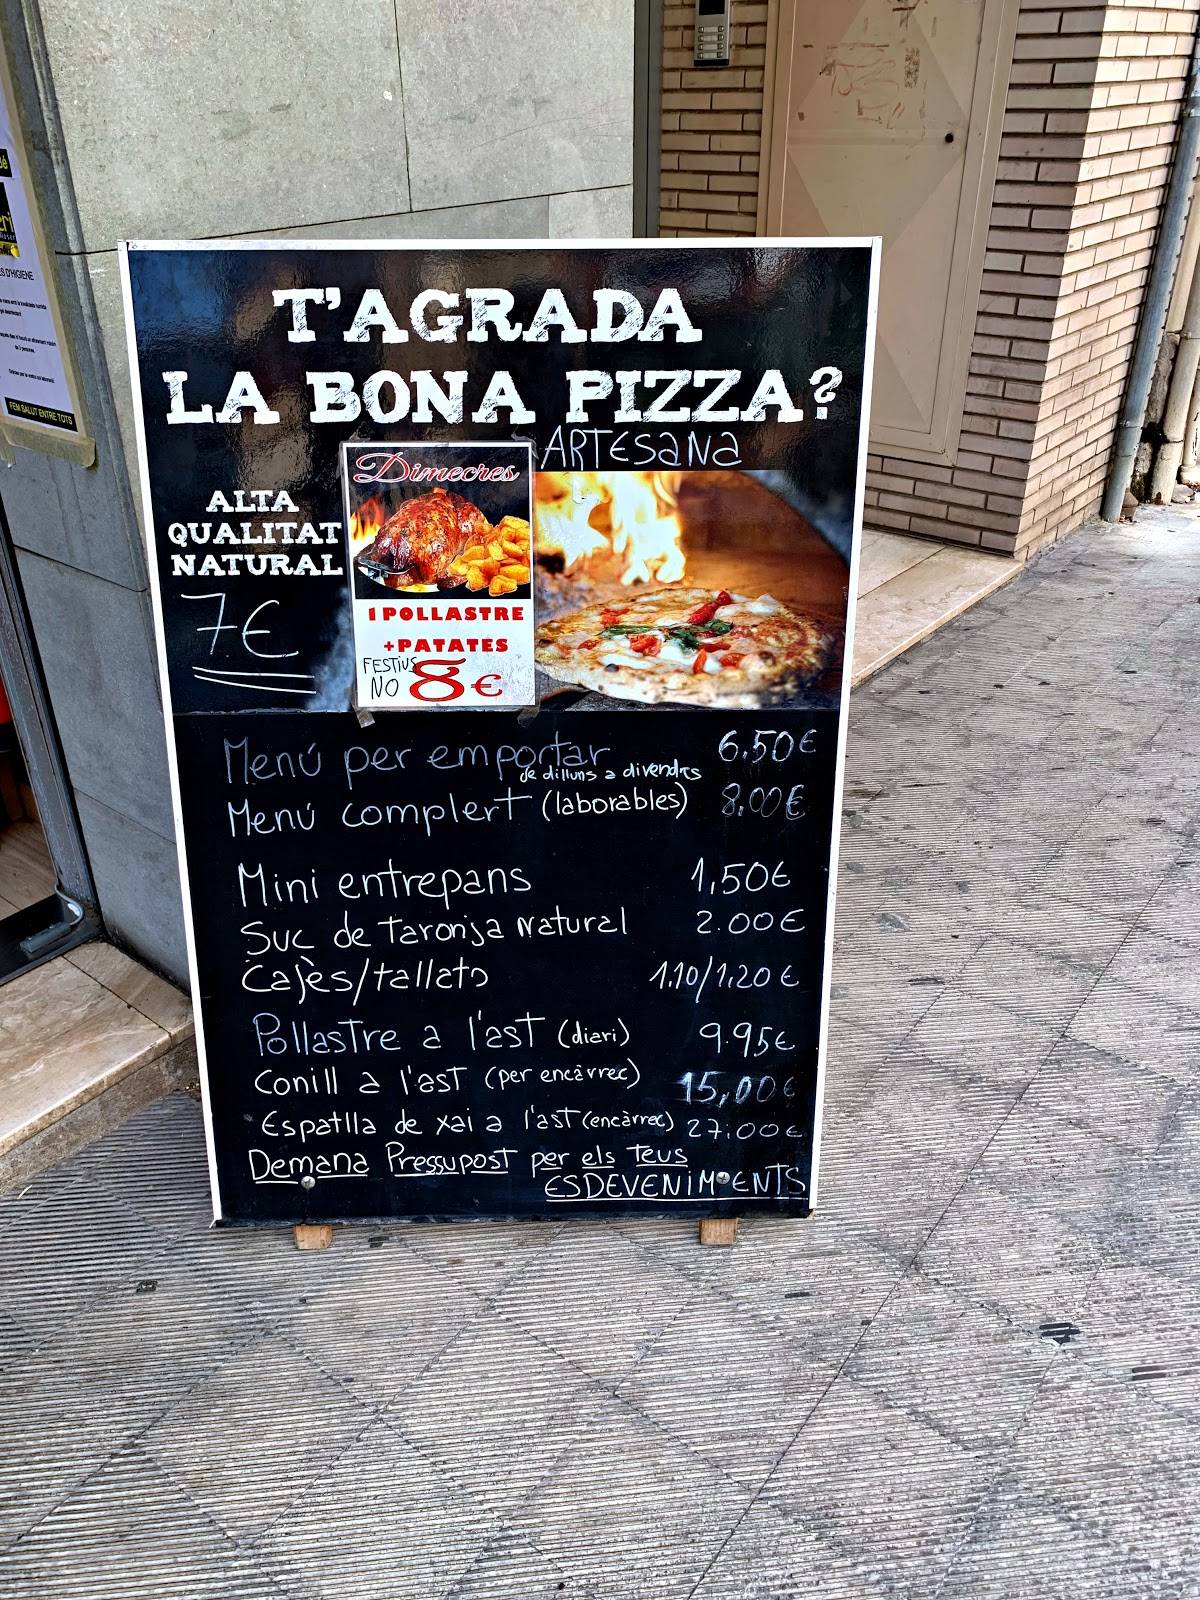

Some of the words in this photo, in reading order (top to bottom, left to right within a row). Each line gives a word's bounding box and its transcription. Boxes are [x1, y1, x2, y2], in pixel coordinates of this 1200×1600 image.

[272, 286, 703, 344] T'AGRADA
[162, 371, 280, 425] LA
[306, 369, 536, 425] BONA
[566, 366, 843, 424] PIZZA?
[8, 401, 22, 412] FEM
[21, 404, 38, 416] SALUT
[38, 408, 58, 420] ENTRE
[57, 412, 73, 425] TOTS
[353, 451, 520, 483] Dimecres
[206, 490, 299, 513] ALTA
[167, 522, 341, 545] QUALITAT
[171, 553, 343, 577] NATURAL
[383, 606, 524, 621] POLLASTRE
[371, 675, 399, 700] NO
[224, 737, 321, 784] Menú
[344, 745, 412, 790] per
[427, 731, 611, 780] emportar
[520, 766, 537, 783] de
[543, 765, 598, 782] dilluns
[605, 770, 616, 780] a
[228, 799, 315, 837] Menú
[342, 787, 533, 837] complert
[542, 782, 688, 822] (laborables)
[238, 863, 319, 908] Mini
[339, 858, 532, 910] entrepans
[240, 921, 315, 955] Suc
[333, 910, 372, 948] de
[252, 1012, 401, 1057] Pollastre
[422, 1025, 443, 1049] a
[557, 1017, 631, 1049] (diari)
[254, 1065, 338, 1096] Conill
[358, 1071, 381, 1094] a
[484, 1066, 533, 1091] (per
[261, 1110, 377, 1143] Espatlla
[394, 1108, 423, 1136] de
[435, 1107, 473, 1136] xai
[485, 1115, 503, 1133] a
[248, 1148, 371, 1182] Demana
[385, 1141, 518, 1176] Pressupost
[531, 1151, 570, 1178] per
[581, 1145, 616, 1168] els
